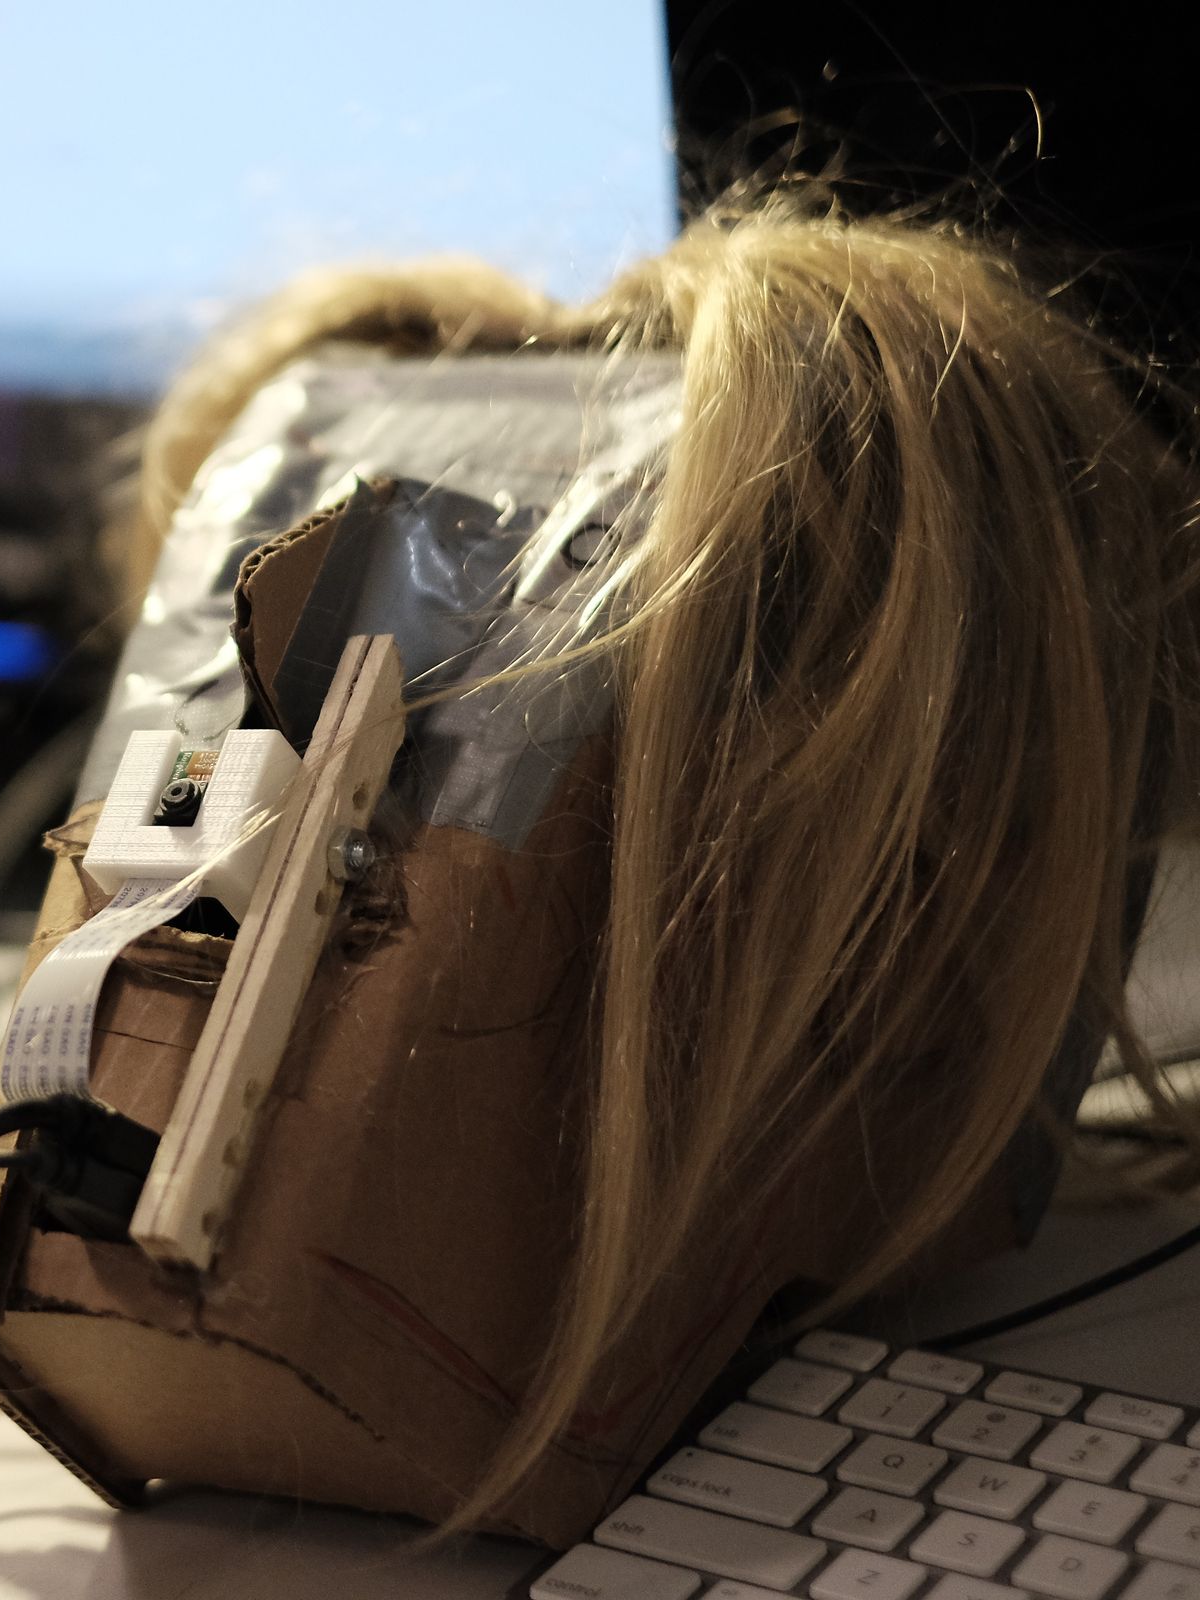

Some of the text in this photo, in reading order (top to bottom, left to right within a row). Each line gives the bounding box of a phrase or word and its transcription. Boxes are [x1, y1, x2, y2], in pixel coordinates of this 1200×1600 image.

[971, 1427, 991, 1441] 2
[882, 1453, 905, 1470] Q
[1068, 1450, 1088, 1464] 3
[661, 1473, 733, 1497] caps lock
[978, 1474, 1008, 1491] W
[1170, 1473, 1189, 1485] 4
[856, 1508, 877, 1524] A
[1081, 1500, 1102, 1516] E
[609, 1519, 646, 1536] shift
[958, 1532, 978, 1547] S
[1059, 1556, 1082, 1572] D
[856, 1568, 881, 1585] Z
